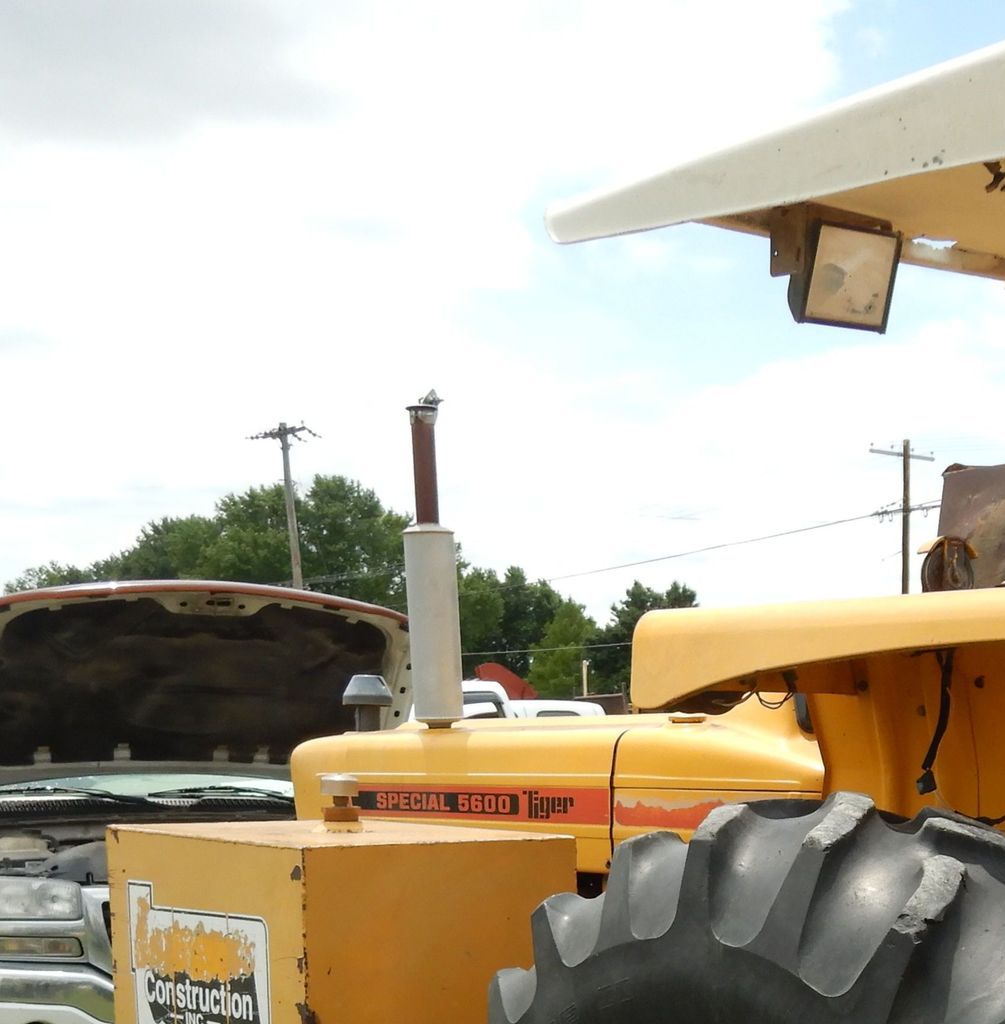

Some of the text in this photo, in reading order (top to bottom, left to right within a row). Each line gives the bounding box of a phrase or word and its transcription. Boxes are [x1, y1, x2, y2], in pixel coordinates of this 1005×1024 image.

[376, 792, 450, 812] SPECIAL
[458, 794, 511, 814] 5600
[144, 969, 254, 1021] Construction
